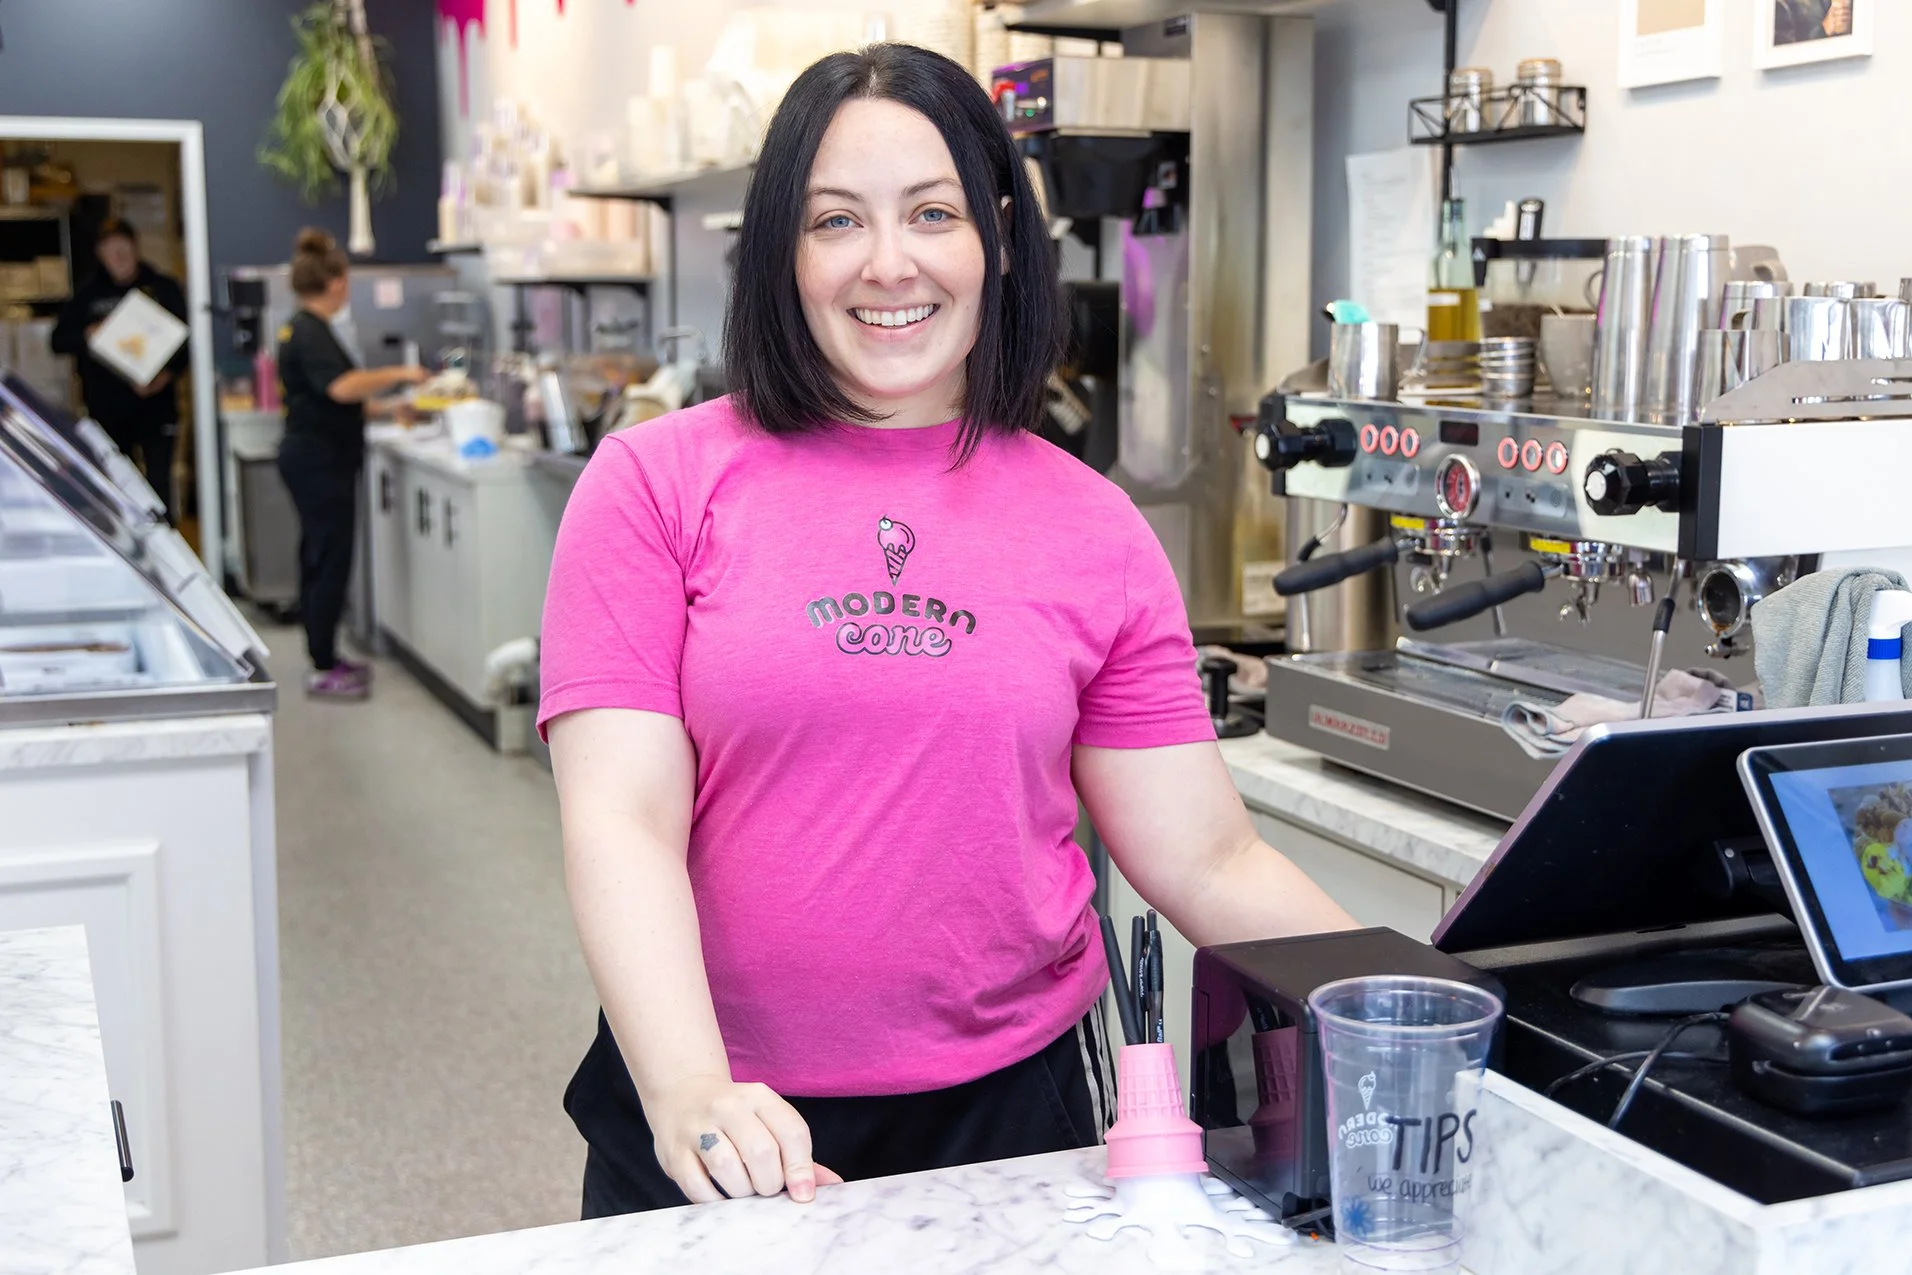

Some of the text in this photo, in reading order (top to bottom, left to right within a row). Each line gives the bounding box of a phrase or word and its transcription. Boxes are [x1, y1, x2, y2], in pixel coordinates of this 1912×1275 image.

[806, 591, 977, 635] MODERN
[836, 622, 952, 657] cone
[1384, 1109, 1477, 1175] TIPS
[1368, 1175, 1393, 1195] we
